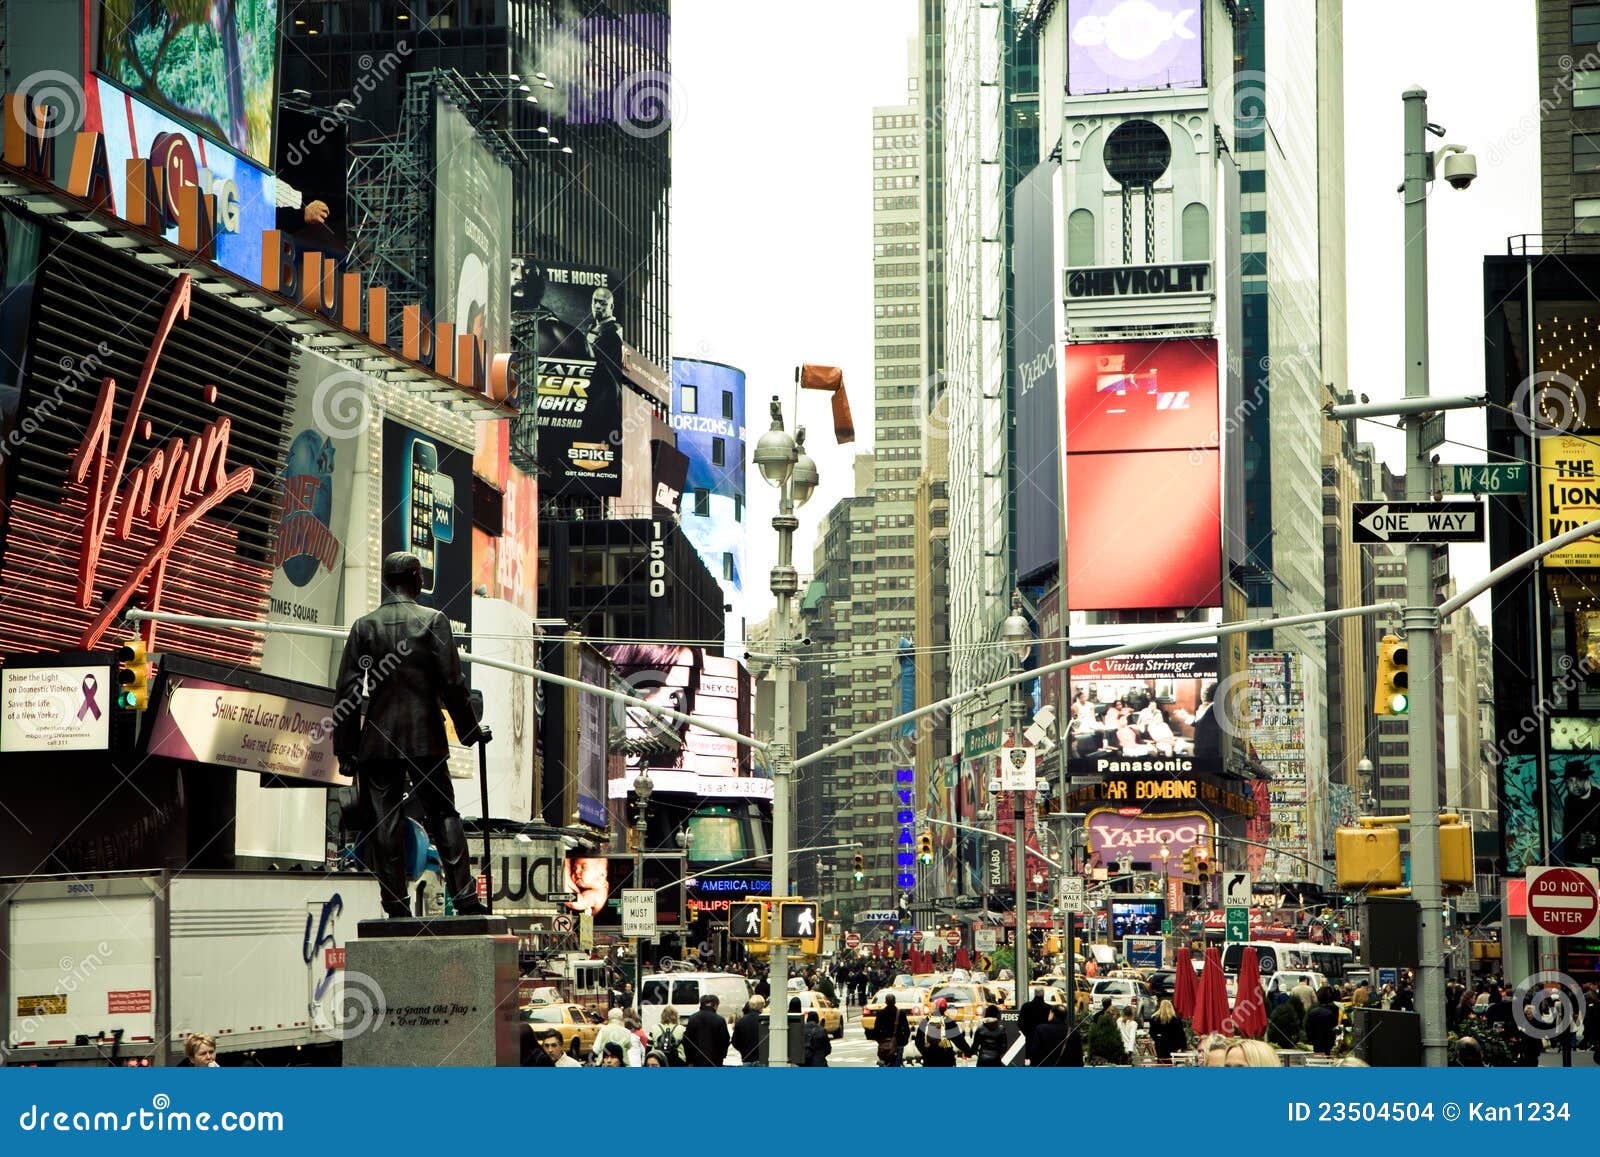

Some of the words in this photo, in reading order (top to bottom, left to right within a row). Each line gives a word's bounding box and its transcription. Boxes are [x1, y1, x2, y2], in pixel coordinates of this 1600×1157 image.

[547, 268, 568, 284] THE
[571, 271, 608, 287] HOUSE
[1068, 266, 1208, 297] CHEVROLET
[567, 448, 615, 461] SPIKE
[72, 272, 255, 652] Virgin
[1555, 459, 1594, 478] THE
[1459, 469, 1472, 488] W
[1479, 467, 1500, 491] 46
[1506, 466, 1521, 481] ST
[1548, 484, 1600, 515] LION
[436, 507, 449, 526] XM
[1372, 514, 1409, 531] ONE
[1427, 514, 1467, 531] WAY
[650, 521, 665, 598] 1500
[270, 598, 291, 616] TIMES
[292, 603, 319, 623] SQUARE
[1089, 661, 1102, 672] C.
[1105, 660, 1144, 672] Vivian
[1145, 659, 1195, 673] Stringer
[8, 673, 28, 682] Shine
[1097, 759, 1193, 772] Panasonic
[1102, 780, 1128, 799] CAR
[1135, 780, 1197, 799] BOMBING
[1093, 824, 1206, 848] YAHOO!
[701, 880, 748, 891] AMERICA
[1540, 881, 1557, 892] DO
[1561, 882, 1585, 893] NOT
[624, 895, 639, 903] RIGHT
[640, 895, 654, 903] LANE
[1226, 896, 1247, 905] ONLY
[630, 908, 648, 918] MUST
[1543, 911, 1582, 923] ENTER
[624, 922, 638, 931] TURN
[639, 922, 654, 931] RIGHT
[405, 1004, 430, 1016] Grand
[433, 1003, 448, 1014] Old
[450, 1003, 469, 1016] Flag
[398, 1016, 417, 1026] Over
[418, 1016, 441, 1026] There
